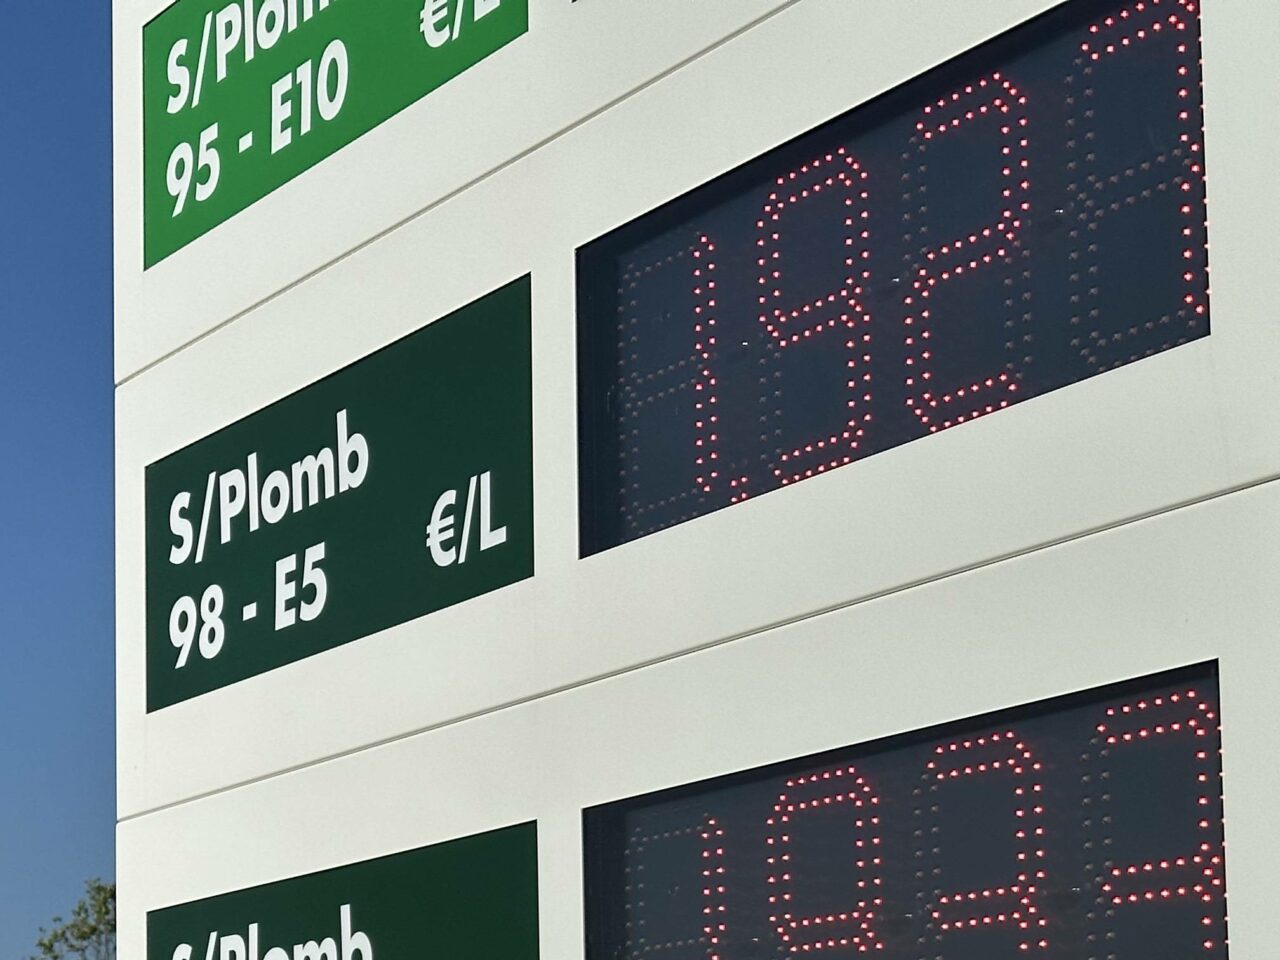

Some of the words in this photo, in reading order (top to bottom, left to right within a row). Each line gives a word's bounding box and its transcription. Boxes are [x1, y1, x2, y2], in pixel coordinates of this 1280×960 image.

[166, 0, 336, 114] S/Plo
[166, 122, 221, 218] 95
[238, 131, 253, 153] -
[270, 39, 349, 155] E10
[694, 0, 1209, 503] 1.927
[169, 408, 369, 565] S/Plomb
[426, 471, 507, 567] €/L
[169, 584, 225, 669] 98
[242, 601, 257, 621] -
[274, 541, 328, 631] E5
